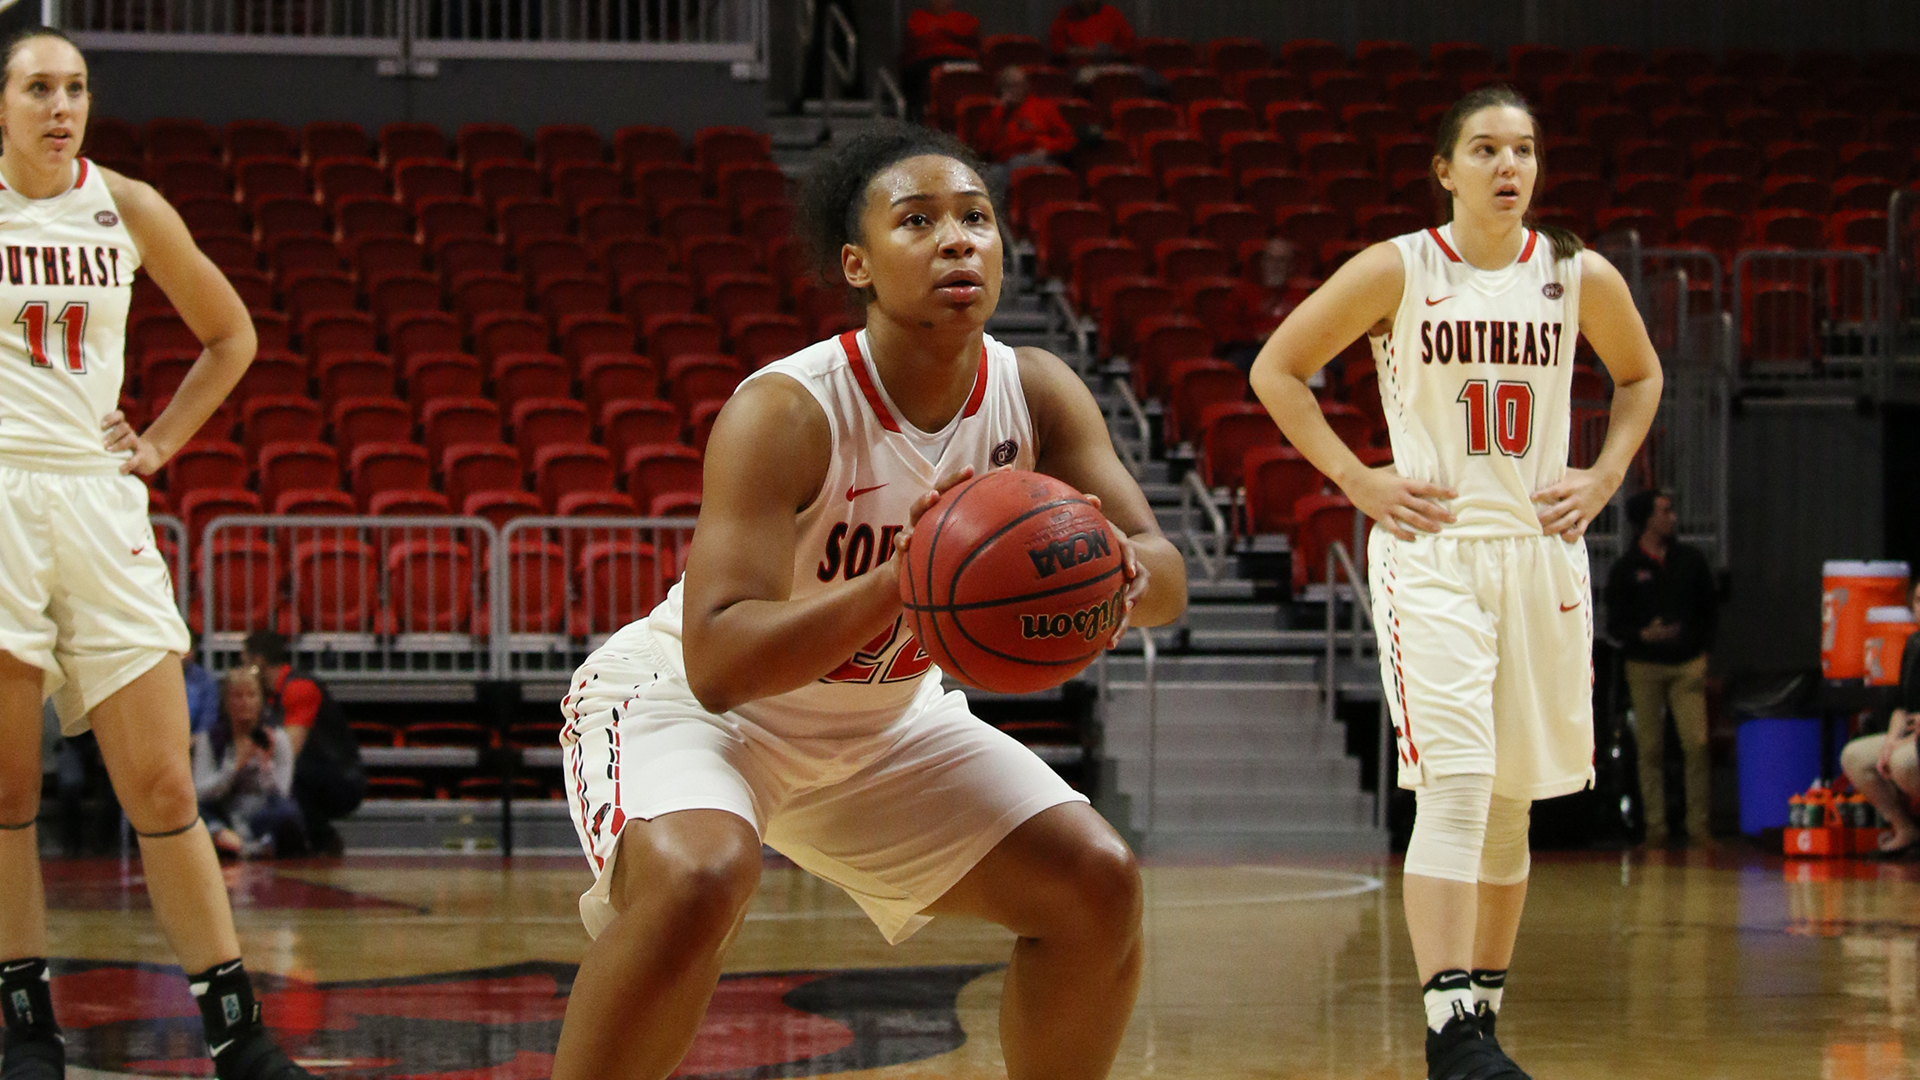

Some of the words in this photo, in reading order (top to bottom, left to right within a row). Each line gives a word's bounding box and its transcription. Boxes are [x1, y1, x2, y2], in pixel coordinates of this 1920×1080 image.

[0, 246, 120, 286] UTHEAST
[14, 301, 89, 374] 11
[1420, 320, 1563, 366] SOUTHEAST
[1455, 379, 1535, 459] 10
[1028, 528, 1111, 578] NCAA
